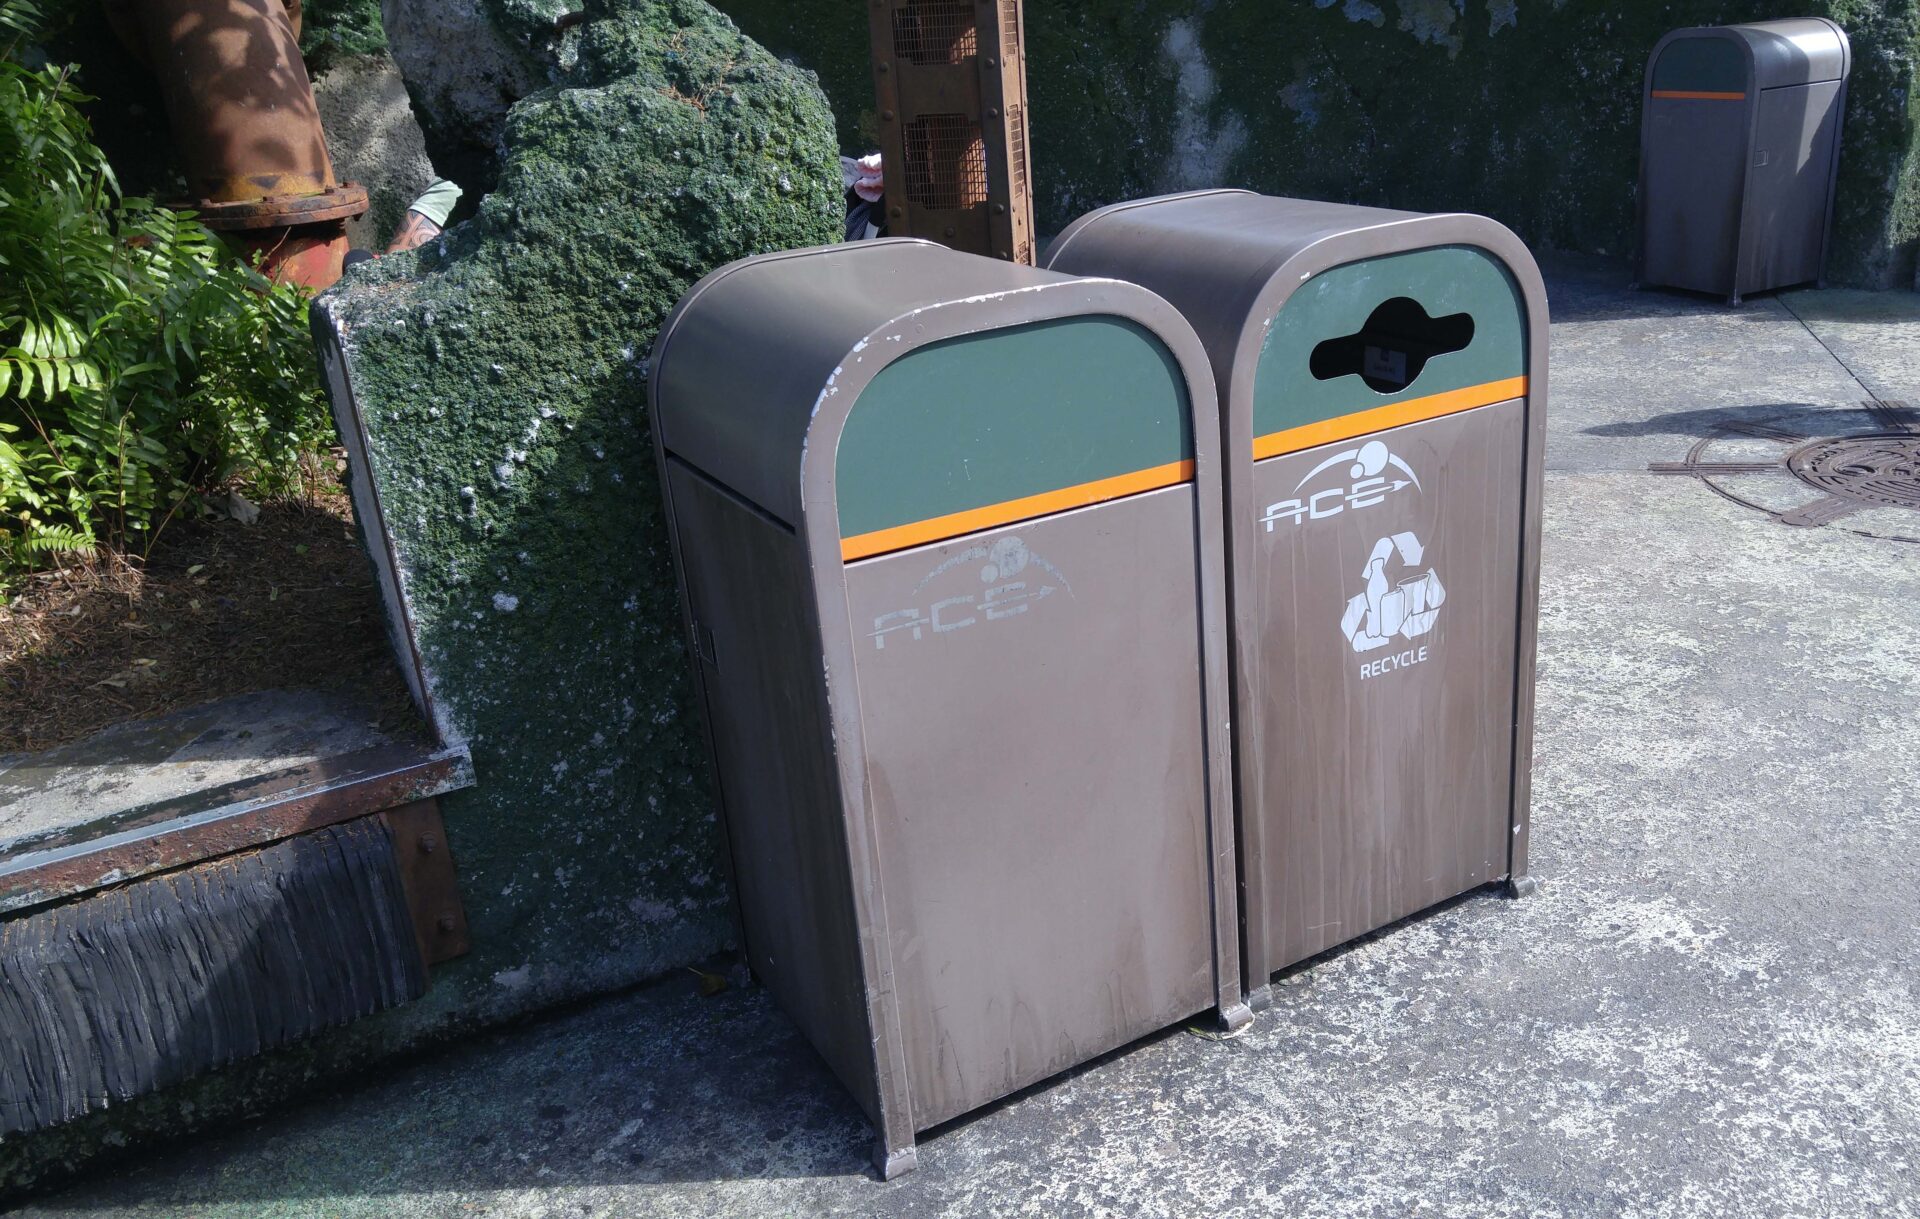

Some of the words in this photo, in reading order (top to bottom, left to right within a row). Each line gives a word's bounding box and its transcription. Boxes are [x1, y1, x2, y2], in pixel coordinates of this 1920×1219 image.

[1258, 476, 1388, 533] ACE
[865, 581, 1031, 650] ACE
[1360, 645, 1428, 681] RECYCLE
